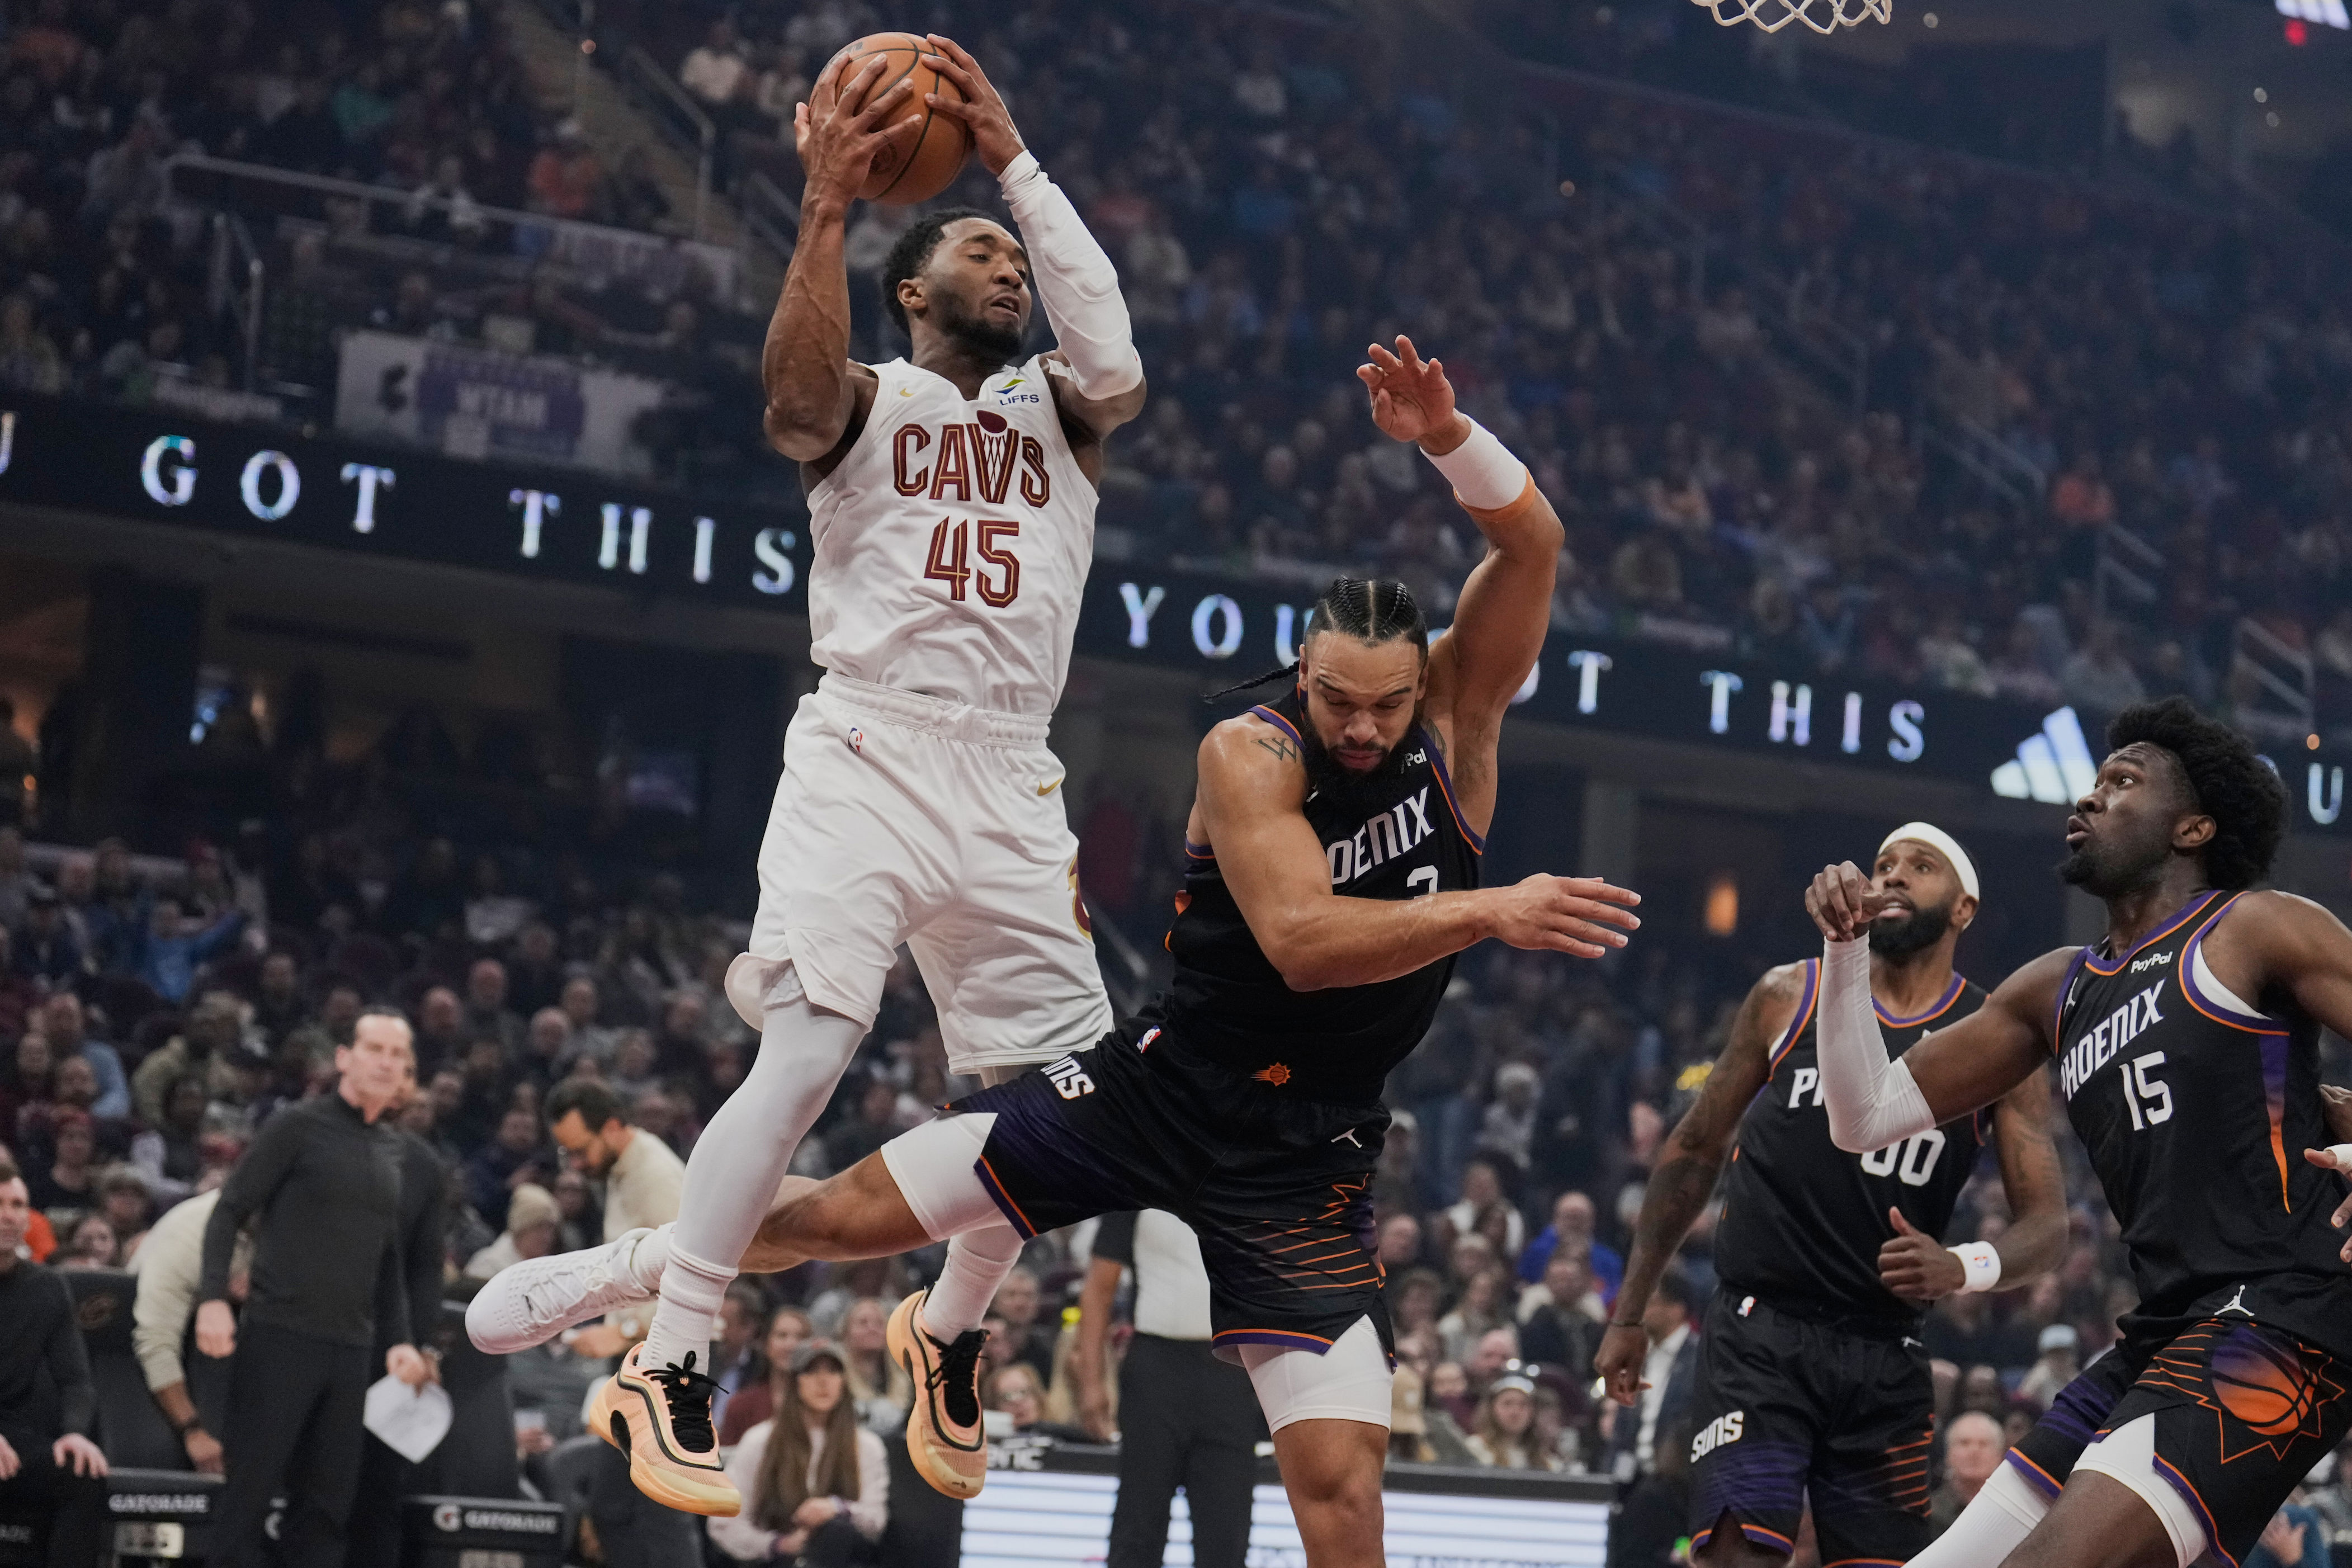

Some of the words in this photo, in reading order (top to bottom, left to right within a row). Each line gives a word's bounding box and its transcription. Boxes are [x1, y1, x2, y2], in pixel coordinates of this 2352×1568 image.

[999, 394, 1040, 405] LIFFS
[893, 423, 1050, 508] CAVS
[140, 434, 396, 533] GOT
[508, 489, 796, 594] THIS
[1699, 670, 1925, 763] THIS
[923, 516, 1019, 608] 45
[1401, 748, 1427, 774] Pal
[1326, 785, 1437, 885] OENIX
[2131, 951, 2173, 974] PayPal
[2060, 977, 2166, 1102] PHOENIX
[2119, 1050, 2174, 1131] 15
[1690, 1410, 1744, 1463] SUNS
[108, 1494, 209, 1513] GATORADE
